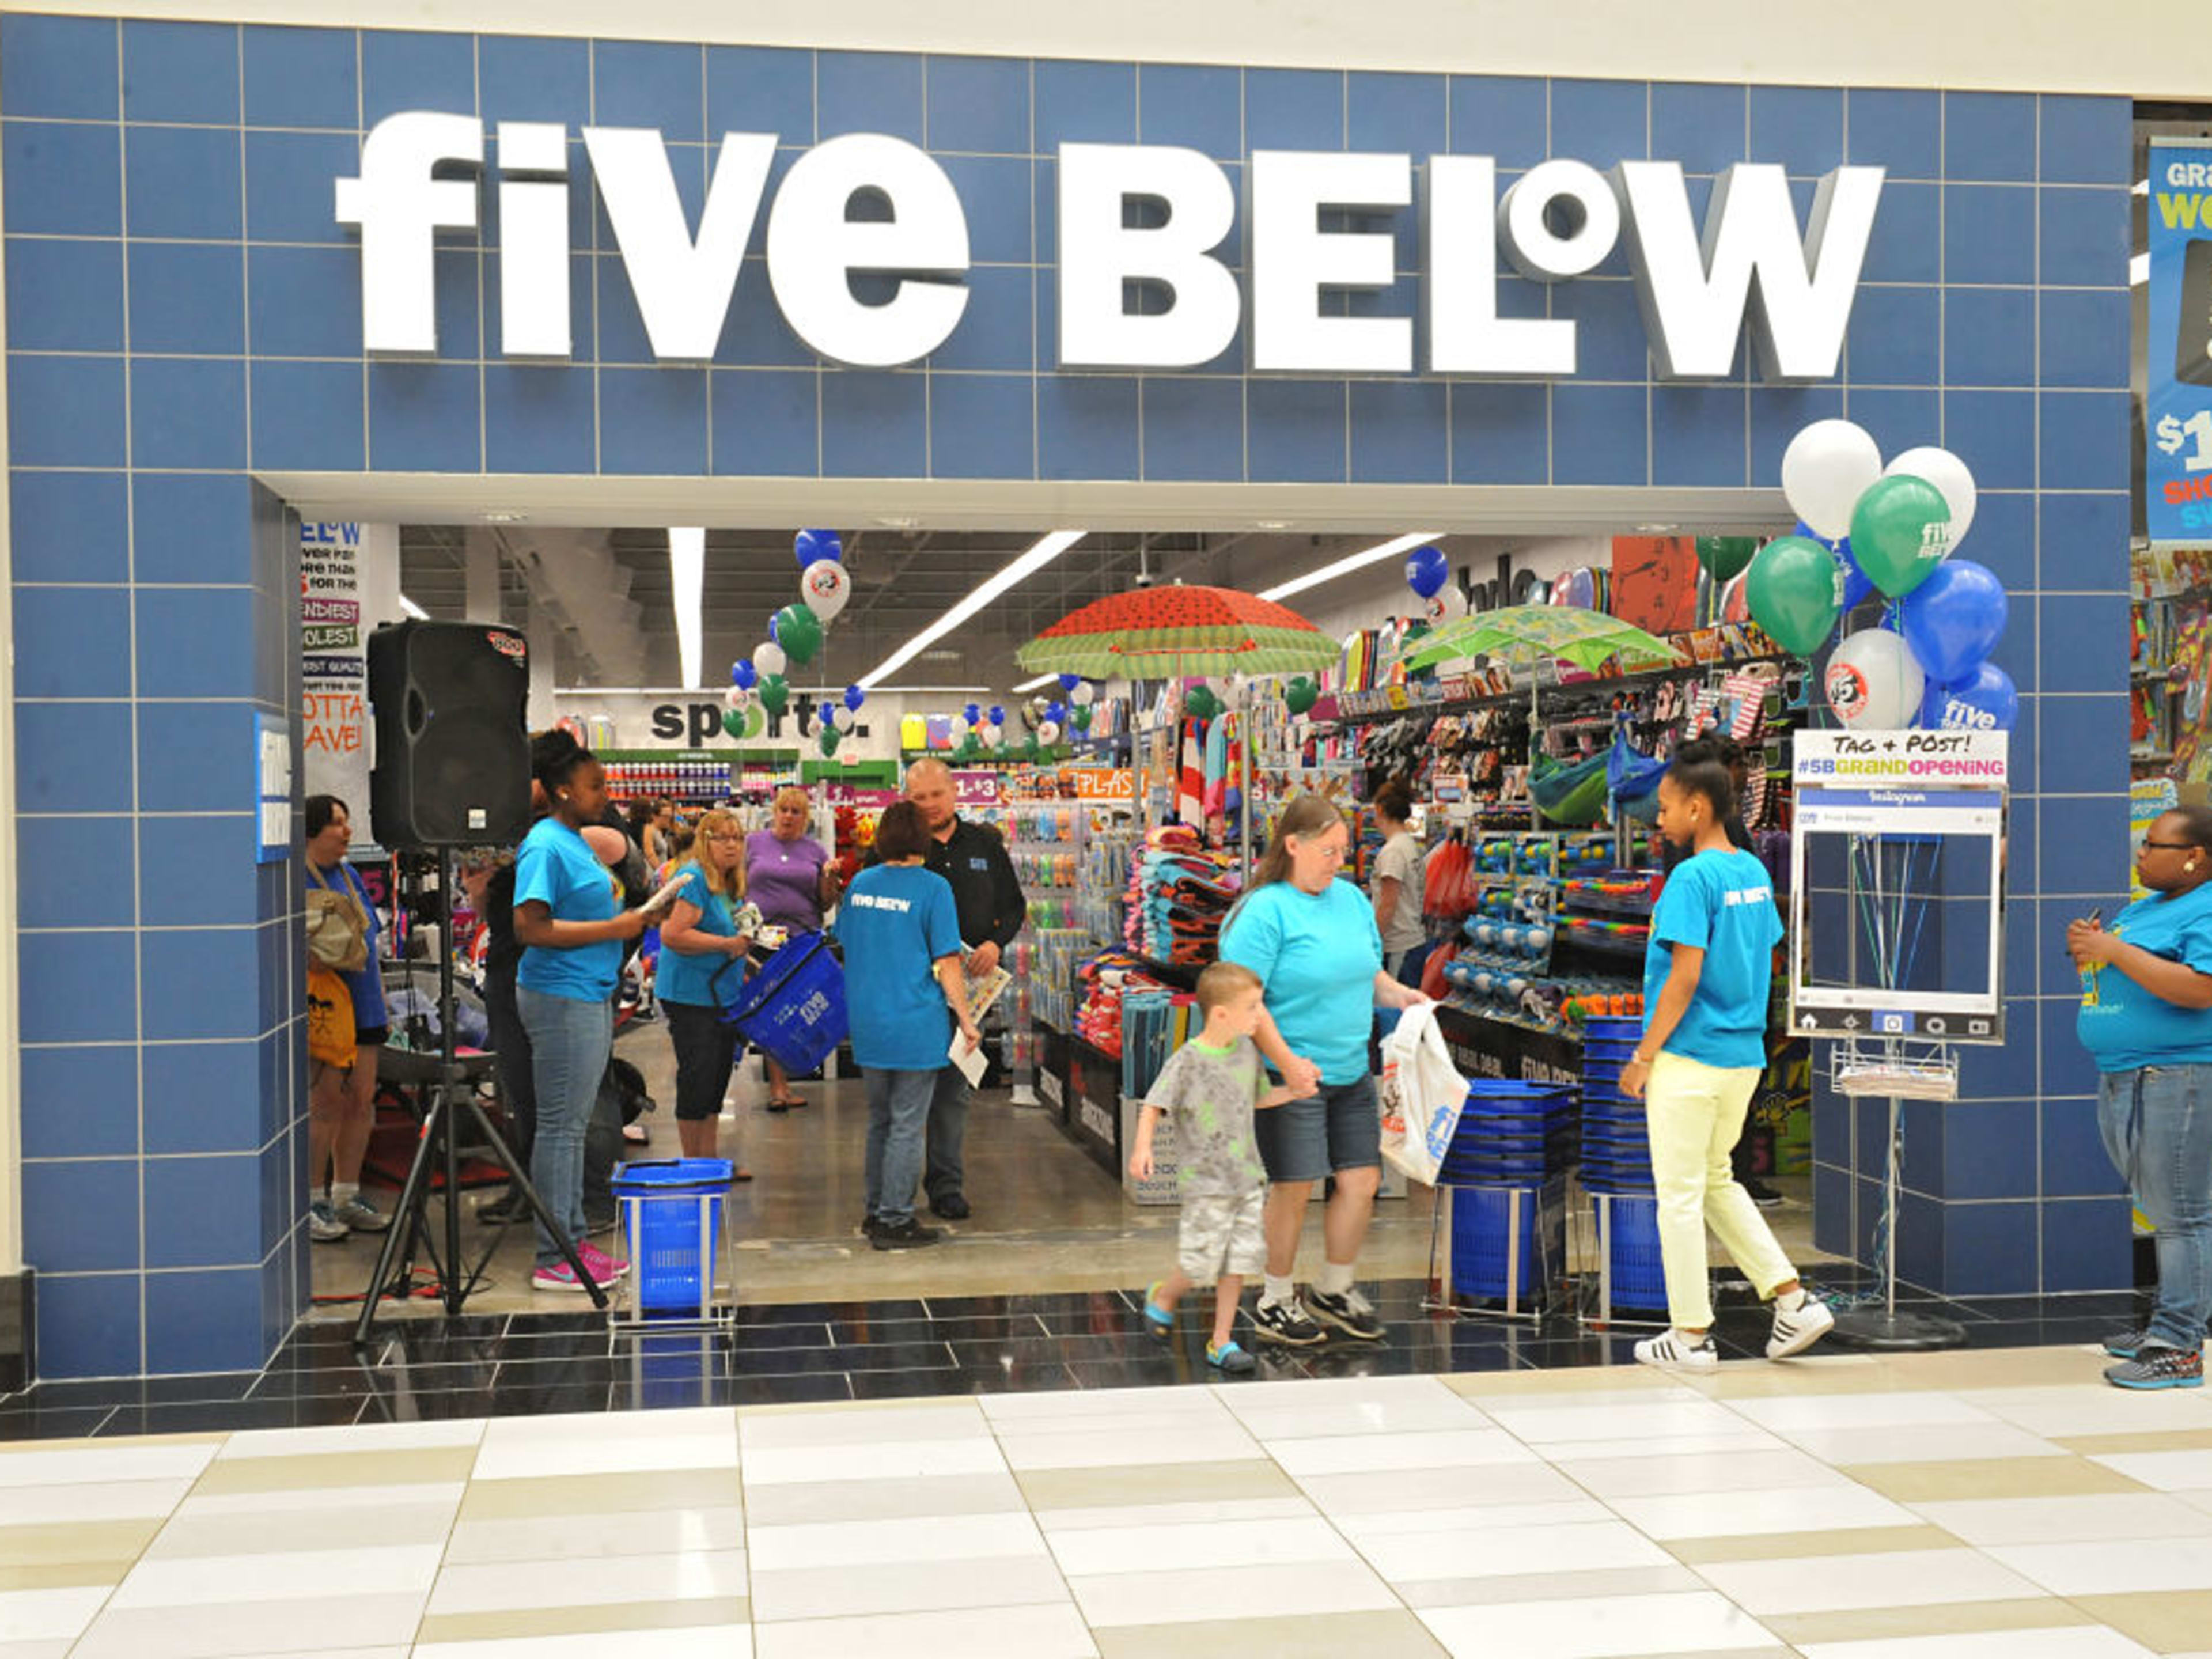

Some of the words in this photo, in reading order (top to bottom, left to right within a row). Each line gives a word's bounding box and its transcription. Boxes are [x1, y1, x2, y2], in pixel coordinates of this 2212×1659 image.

[335, 110, 970, 368] five
[1058, 142, 1887, 378] BELOW
[303, 692, 363, 721] OTTA
[1833, 736, 1876, 754] TAG
[1906, 734, 1971, 753] POST!
